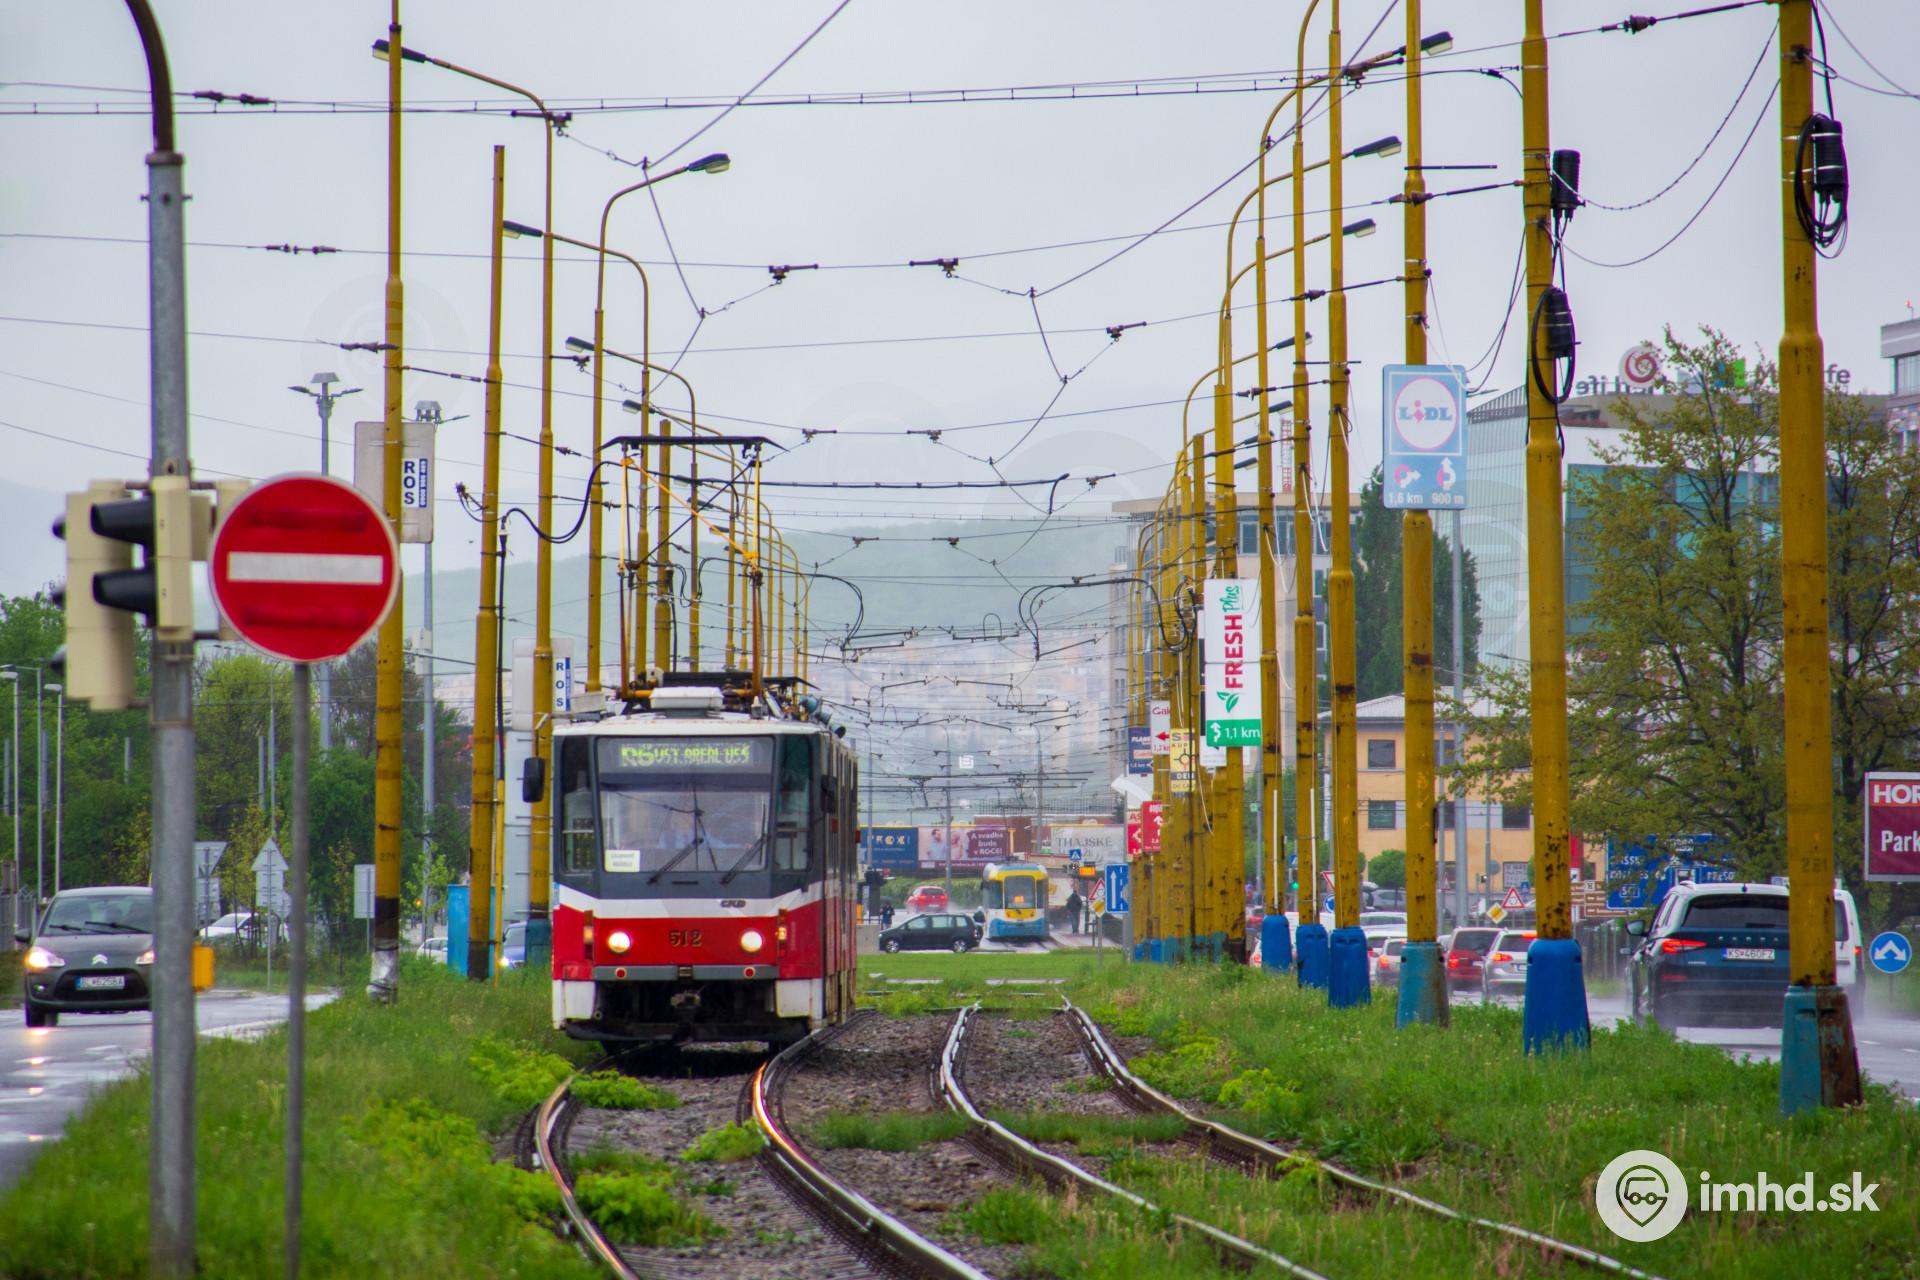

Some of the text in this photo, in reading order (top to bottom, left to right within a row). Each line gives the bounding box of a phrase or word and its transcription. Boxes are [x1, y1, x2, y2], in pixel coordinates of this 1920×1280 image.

[403, 460, 416, 505] ROS
[1407, 492, 1424, 504] km
[1432, 492, 1464, 504] 900 m
[1224, 614, 1244, 689] FRESH
[555, 661, 565, 707] ROS
[1225, 727, 1261, 740] 1,1 km
[669, 929, 702, 947] 512
